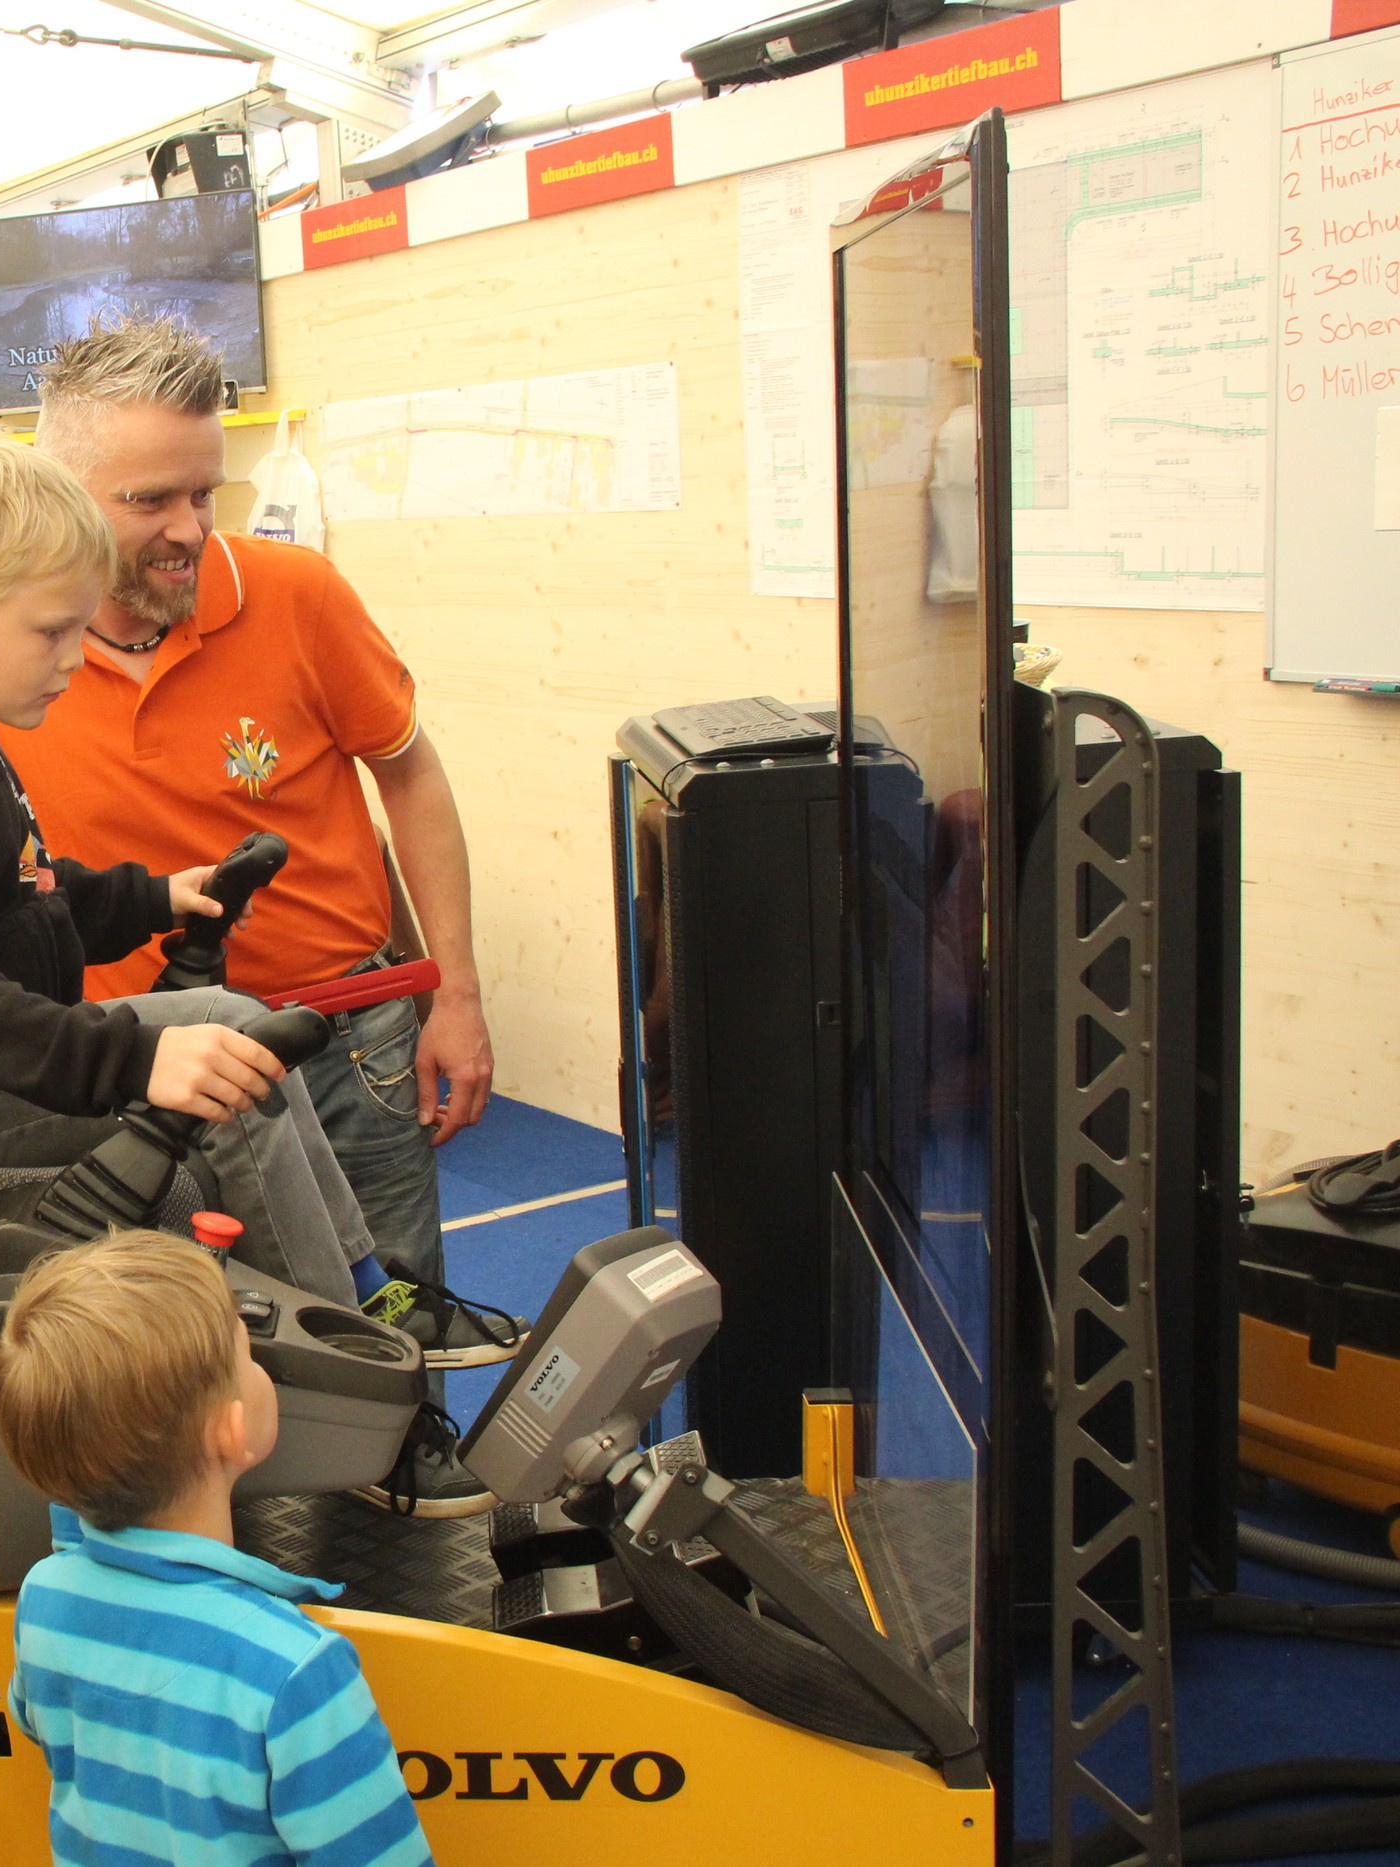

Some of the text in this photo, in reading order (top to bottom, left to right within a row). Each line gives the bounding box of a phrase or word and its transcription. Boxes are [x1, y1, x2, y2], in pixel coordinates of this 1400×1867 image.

[864, 47, 1038, 107] uhunzikertiefbau.ch
[1313, 78, 1394, 115] Hunziker
[541, 144, 658, 184] uhunzikertiefbau.ch
[1288, 136, 1303, 162] 1
[1283, 172, 1302, 198] 2
[1283, 274, 1297, 308] 4
[1284, 316, 1303, 346] 5
[8, 347, 58, 367] Natu
[1286, 360, 1400, 402] 6 Müller
[529, 1354, 560, 1393] VOLVO
[397, 1750, 686, 1803] OLVO
